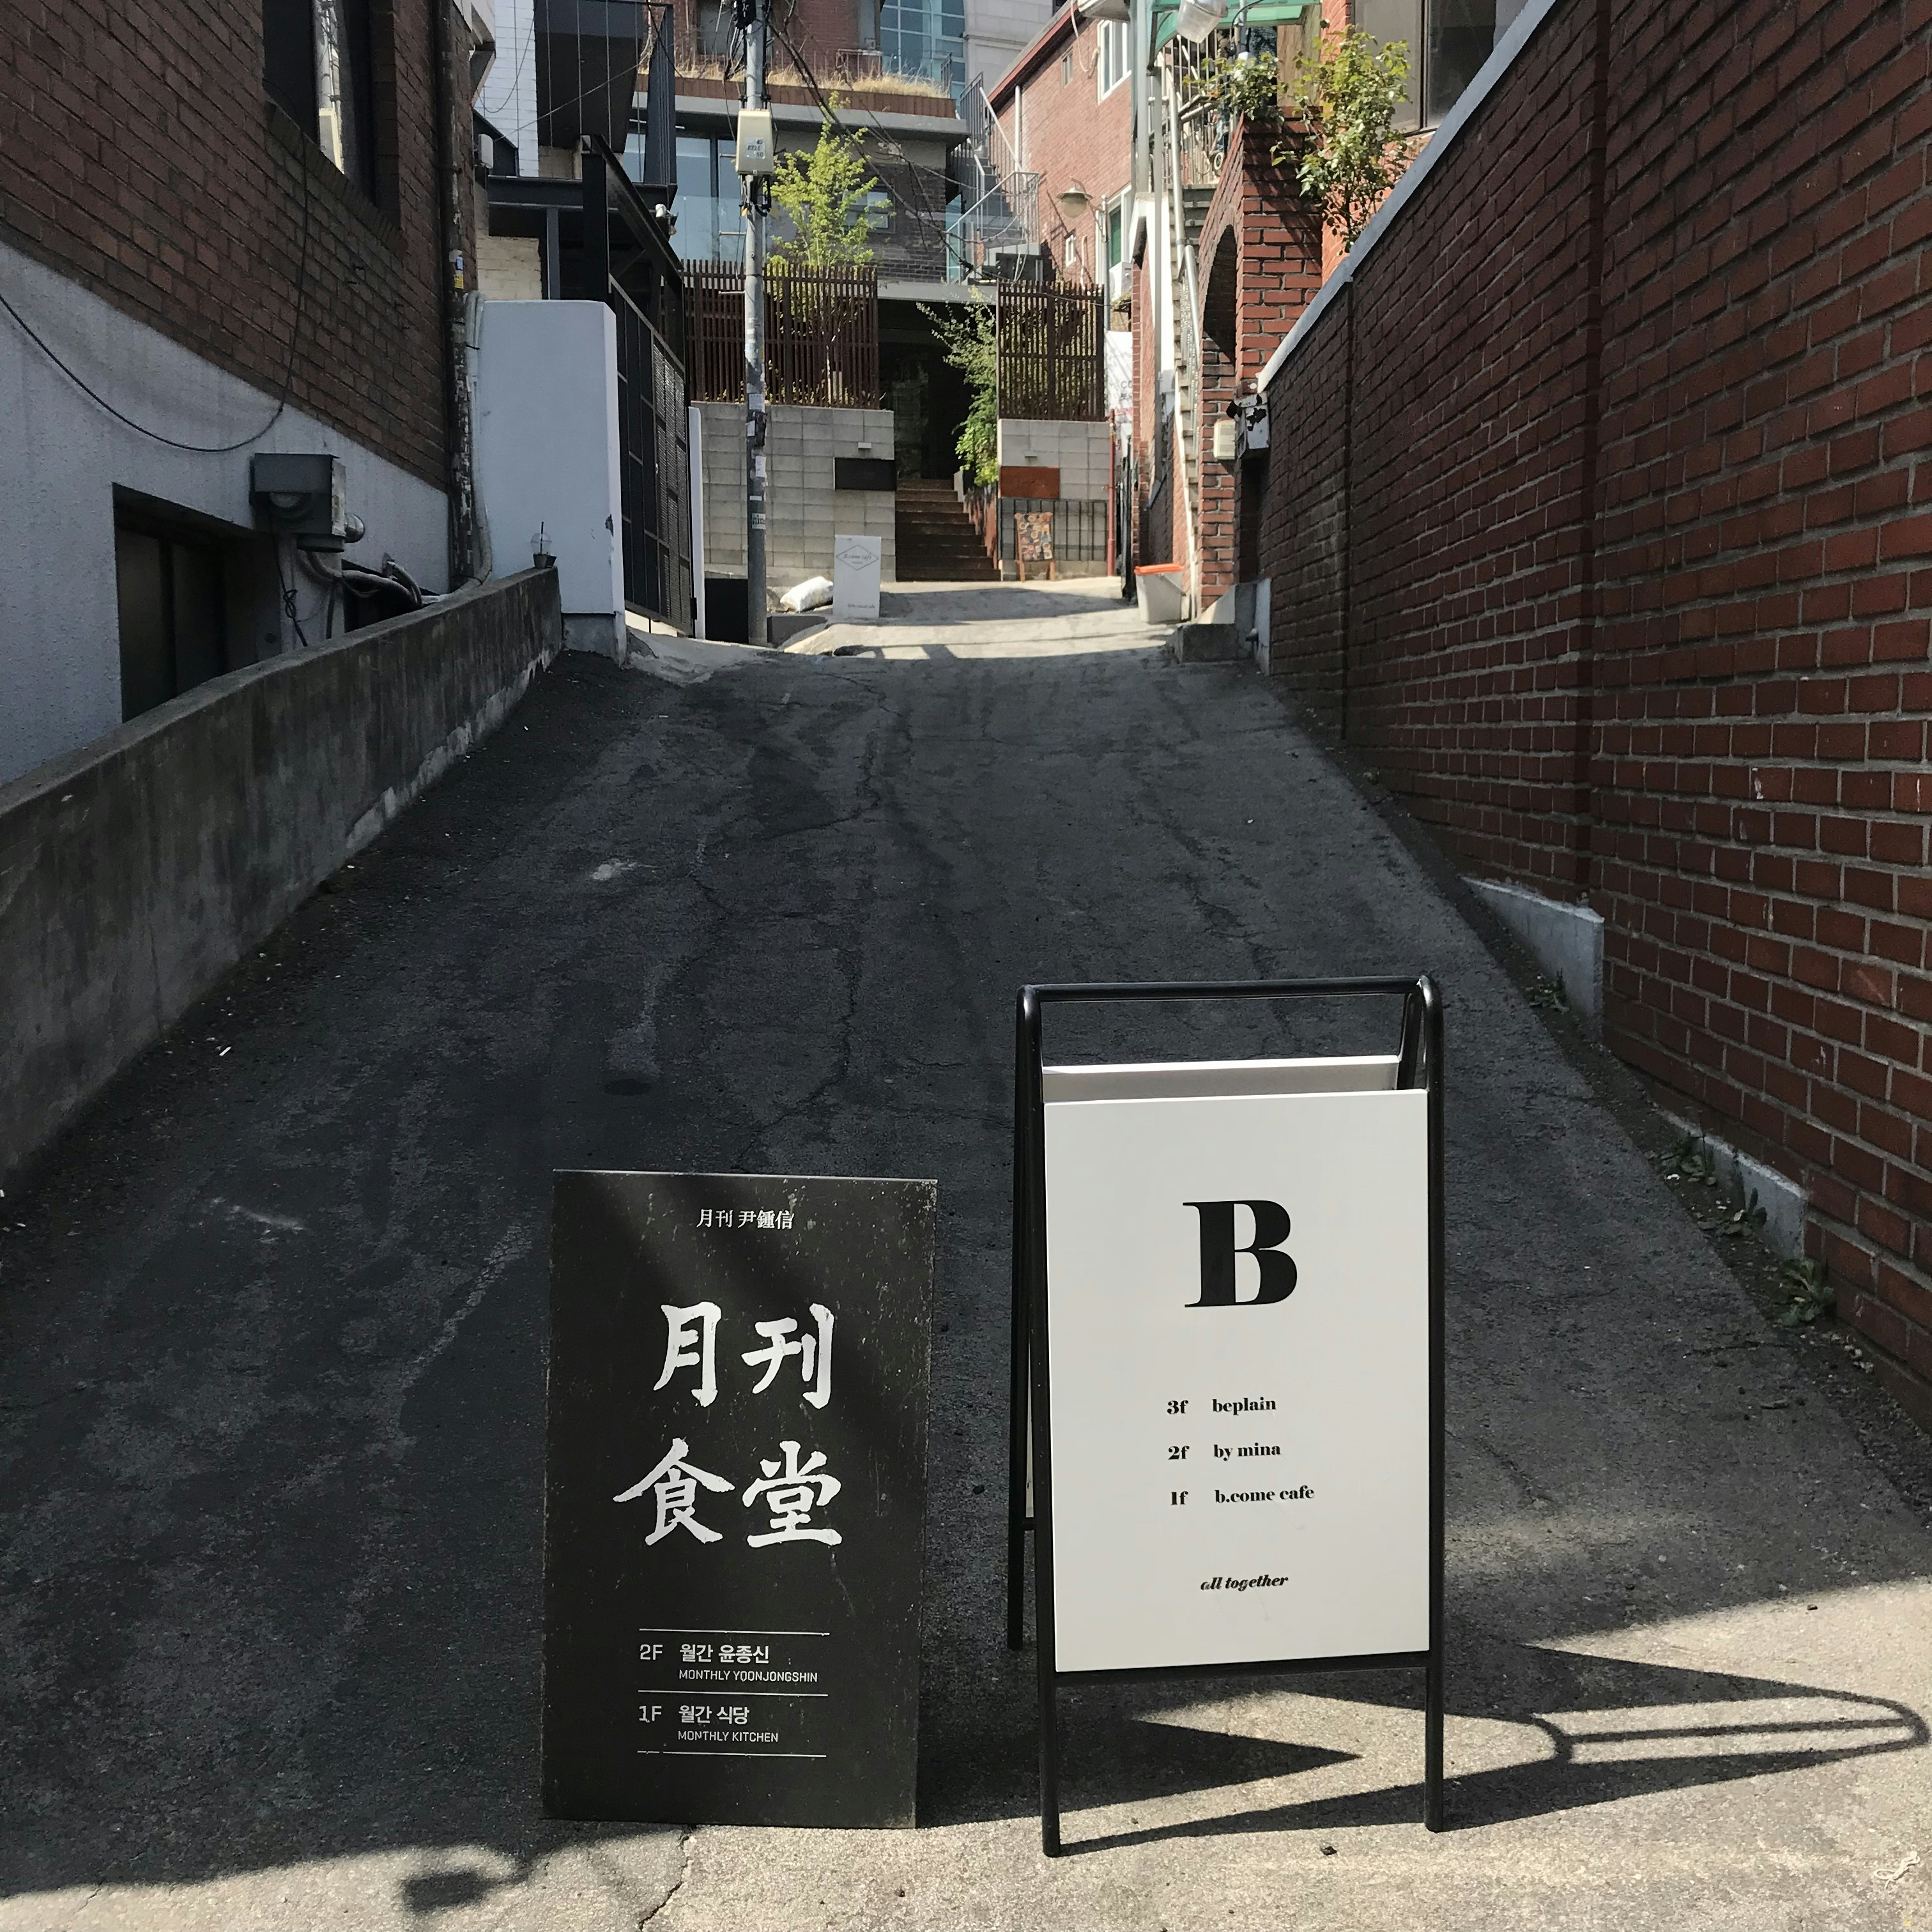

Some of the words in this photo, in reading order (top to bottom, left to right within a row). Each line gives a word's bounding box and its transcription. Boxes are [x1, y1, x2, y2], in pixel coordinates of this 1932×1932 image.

[696, 1209, 733, 1228] 月刊
[1183, 1200, 1298, 1307] B
[653, 1301, 835, 1409] 月刊
[1167, 1400, 1189, 1414] 3f
[1212, 1397, 1276, 1416] beplain
[1168, 1445, 1190, 1460] 2f
[1213, 1444, 1233, 1462] by
[1237, 1443, 1281, 1457] mina
[612, 1438, 843, 1548] 食堂
[1170, 1491, 1189, 1505] 1f
[1215, 1489, 1275, 1503] b.come
[1279, 1485, 1315, 1500] cafe
[1200, 1576, 1223, 1591] all
[1225, 1574, 1289, 1592] together
[640, 1644, 663, 1660] 2F
[679, 1643, 714, 1662] 월간
[718, 1644, 769, 1664] 윤종신
[678, 1669, 731, 1681] MONTHLY
[733, 1670, 818, 1683] YOONJONGSHIN
[639, 1705, 662, 1723] 1F
[678, 1705, 712, 1724] 월간
[716, 1706, 750, 1725] 식당
[678, 1730, 730, 1742] MONTHLY
[732, 1731, 779, 1743] KITCHEN
